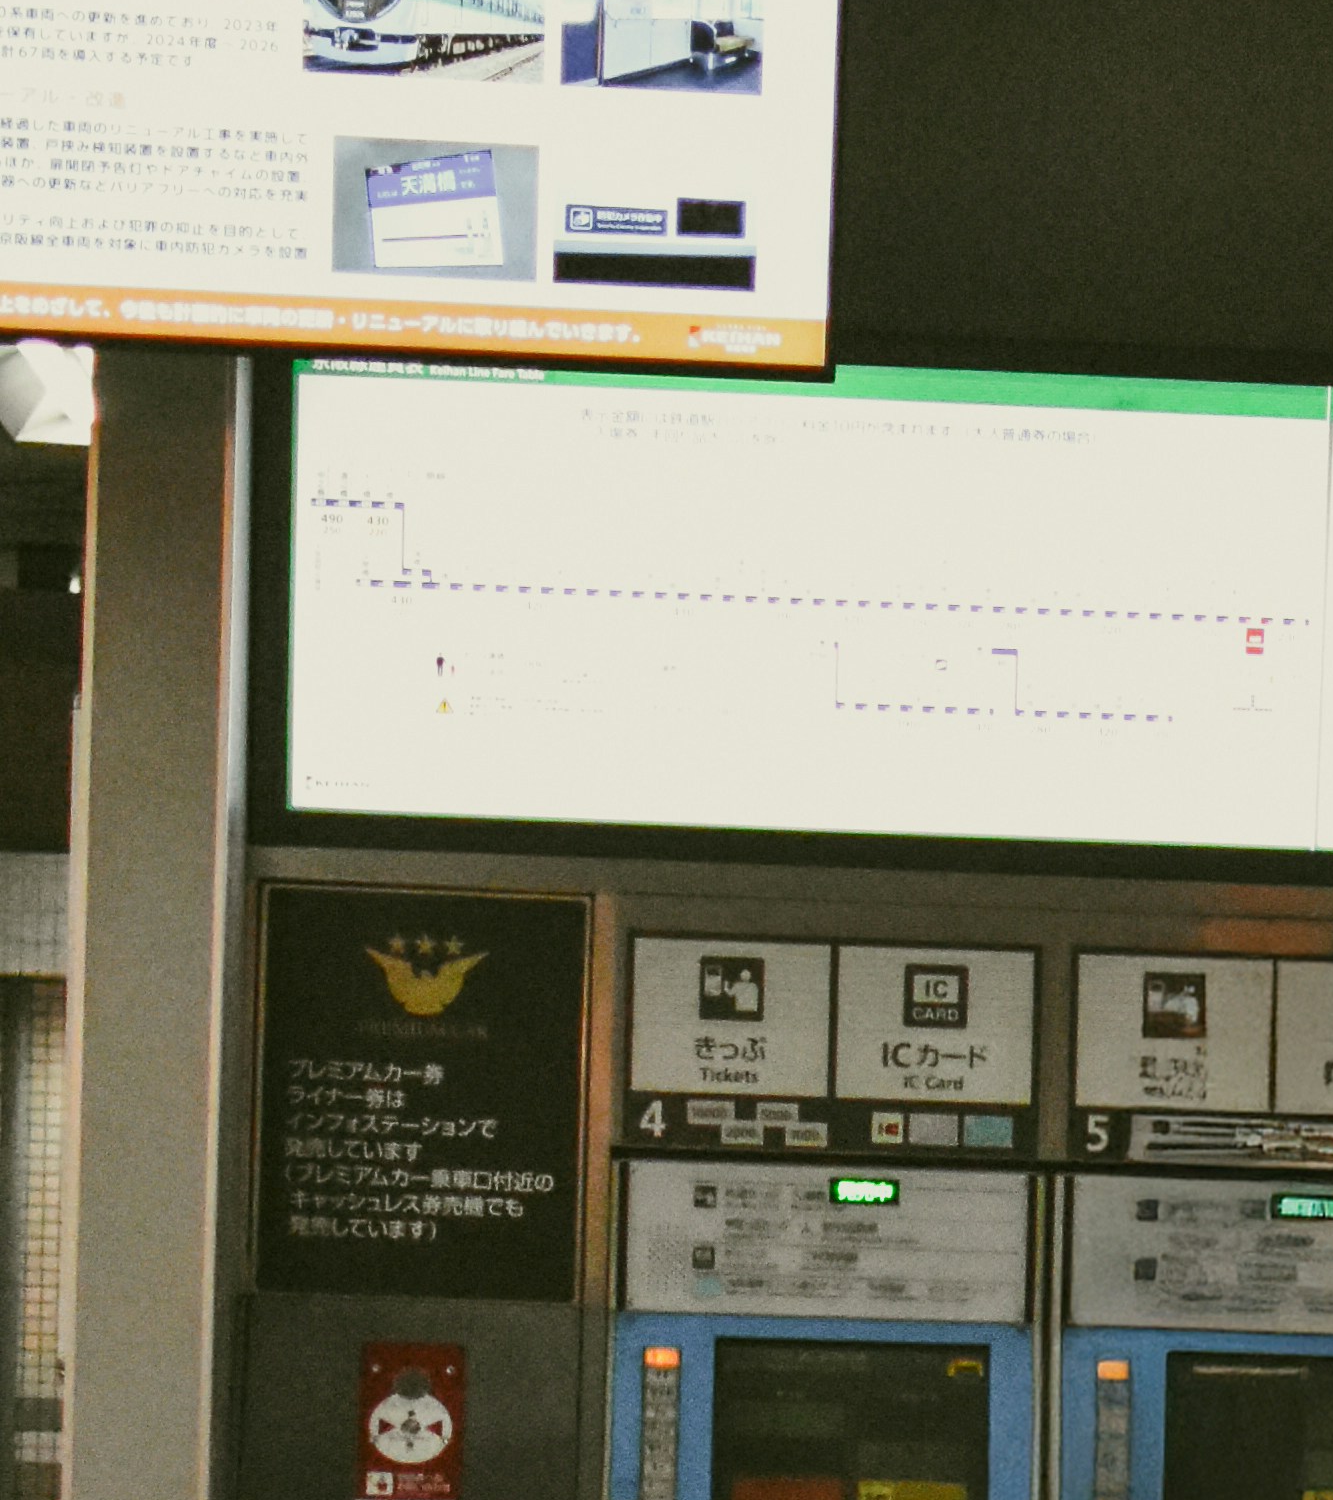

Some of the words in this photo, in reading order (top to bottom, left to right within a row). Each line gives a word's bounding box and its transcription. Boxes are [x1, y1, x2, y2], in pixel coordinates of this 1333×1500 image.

[400, 169, 457, 197] 天満橋
[700, 329, 782, 347] KEIHAN
[429, 364, 466, 378] Keihan
[468, 366, 490, 379] Line
[493, 367, 515, 380] Fare
[517, 368, 545, 381] Table
[321, 513, 344, 524] 490
[924, 980, 948, 999] IC
[912, 1006, 959, 1023] CARD
[694, 1035, 767, 1062] きっぷ
[881, 1041, 988, 1069] ICカード
[289, 1058, 444, 1085] プレミアムカー券
[699, 1067, 759, 1085] Tickets
[903, 1075, 920, 1090] IC
[925, 1075, 965, 1092] Card
[288, 1085, 406, 1109] ライナー券は
[287, 1113, 498, 1139] インフォステーションで
[638, 1100, 666, 1138] 4
[1085, 1113, 1110, 1152] 5
[285, 1137, 423, 1162] 発売しています
